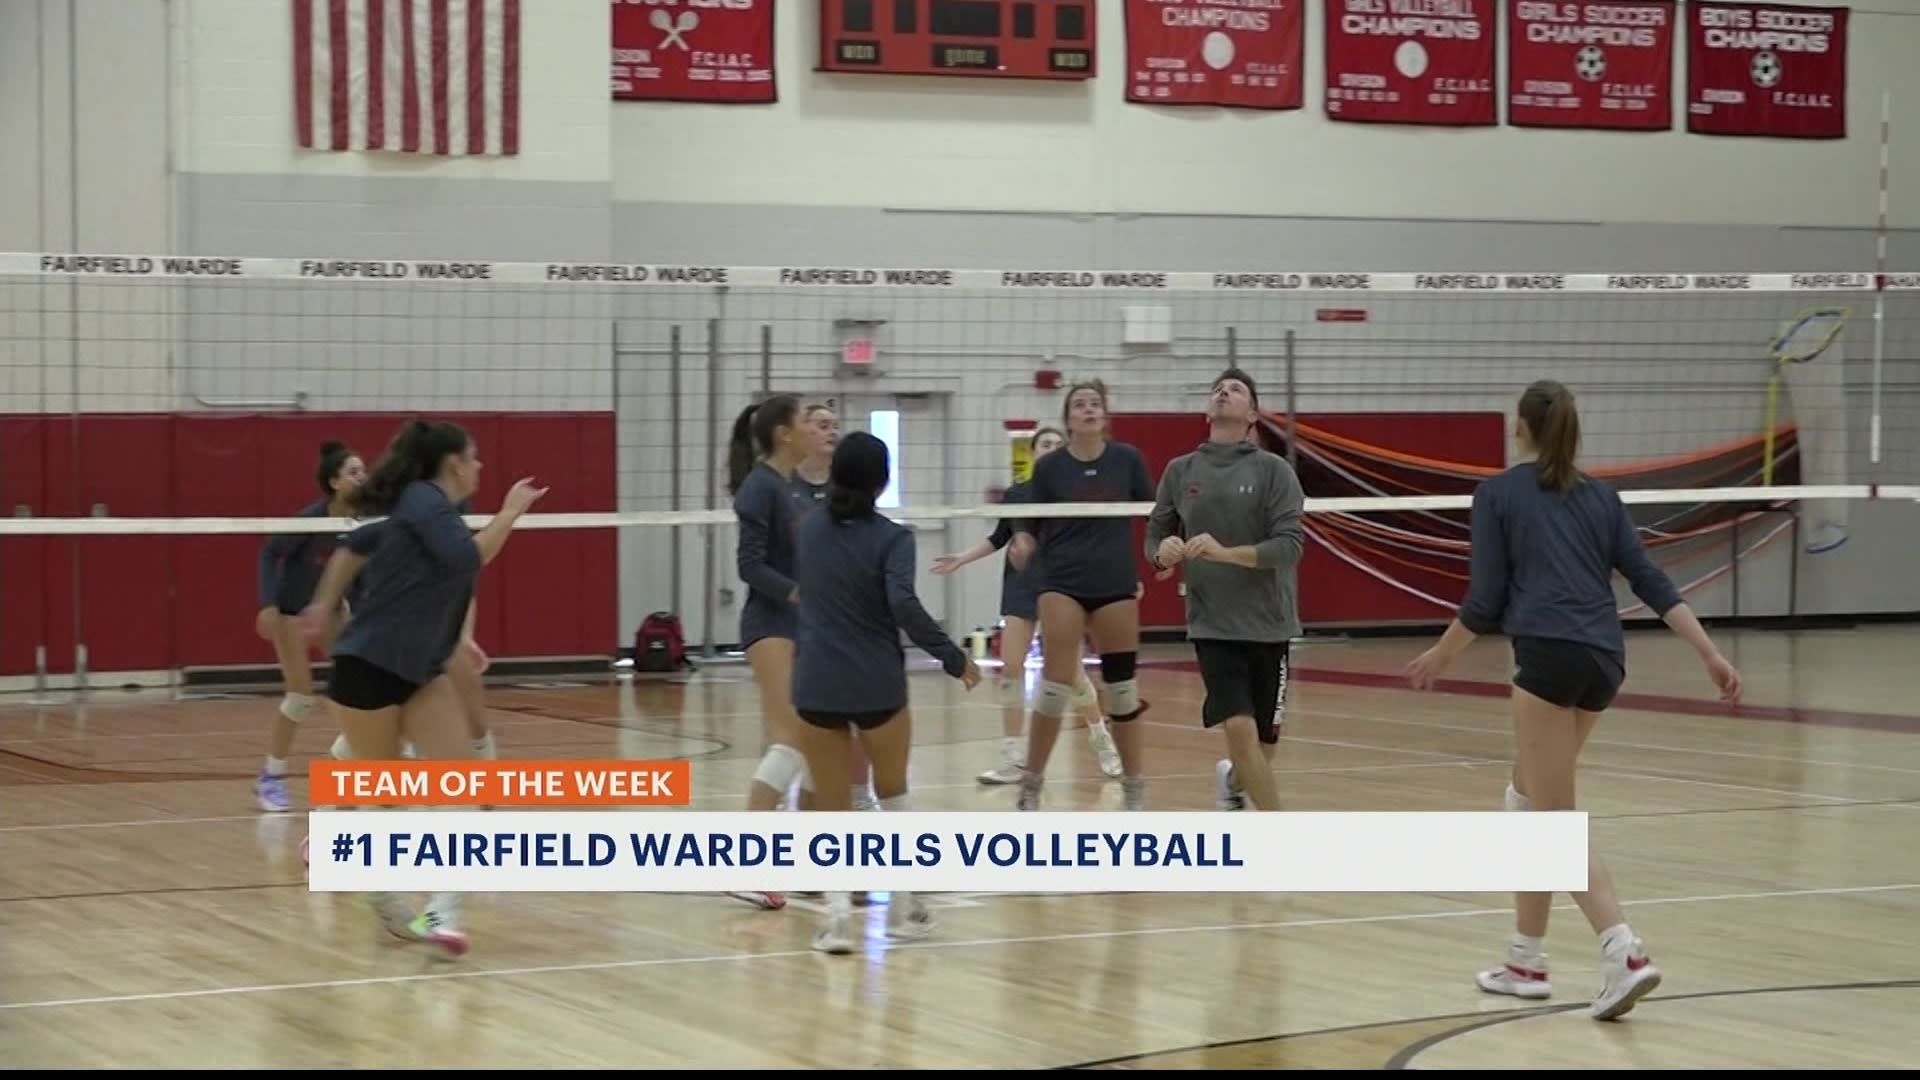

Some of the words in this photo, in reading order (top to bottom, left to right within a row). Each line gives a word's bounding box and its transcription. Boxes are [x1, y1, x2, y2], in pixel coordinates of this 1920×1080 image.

[1161, 7, 1270, 31] CHAMPIONS
[1516, 1, 1578, 22] GIRLS
[1584, 5, 1665, 25] SOCCER
[1700, 8, 1752, 28] BOYS
[1756, 10, 1833, 32] SOCCER
[1342, 15, 1480, 39] CHAMPIONS
[1527, 23, 1656, 46] CHAMPIONS
[1704, 29, 1829, 52] CHAMPIONS
[40, 256, 152, 274] FAIRFIELD
[162, 258, 242, 275] WARDE
[301, 260, 408, 279] FAIRFIELD
[417, 263, 491, 279] WARDE
[547, 265, 647, 281] FAIRFIELD
[656, 267, 728, 283] WARDE
[780, 268, 876, 285] FAIRFIELD
[885, 270, 952, 286] WARDE
[1001, 272, 1093, 287] FAIRFIELD
[1102, 273, 1166, 288] WARDE
[1213, 274, 1300, 289] FAIRFIELD
[1309, 274, 1370, 289] WARDE
[1415, 275, 1497, 290] FAIRFIELD
[1506, 275, 1564, 290] WARDE
[1607, 276, 1688, 290] FAIRFIELD
[1695, 276, 1750, 290] WARDE
